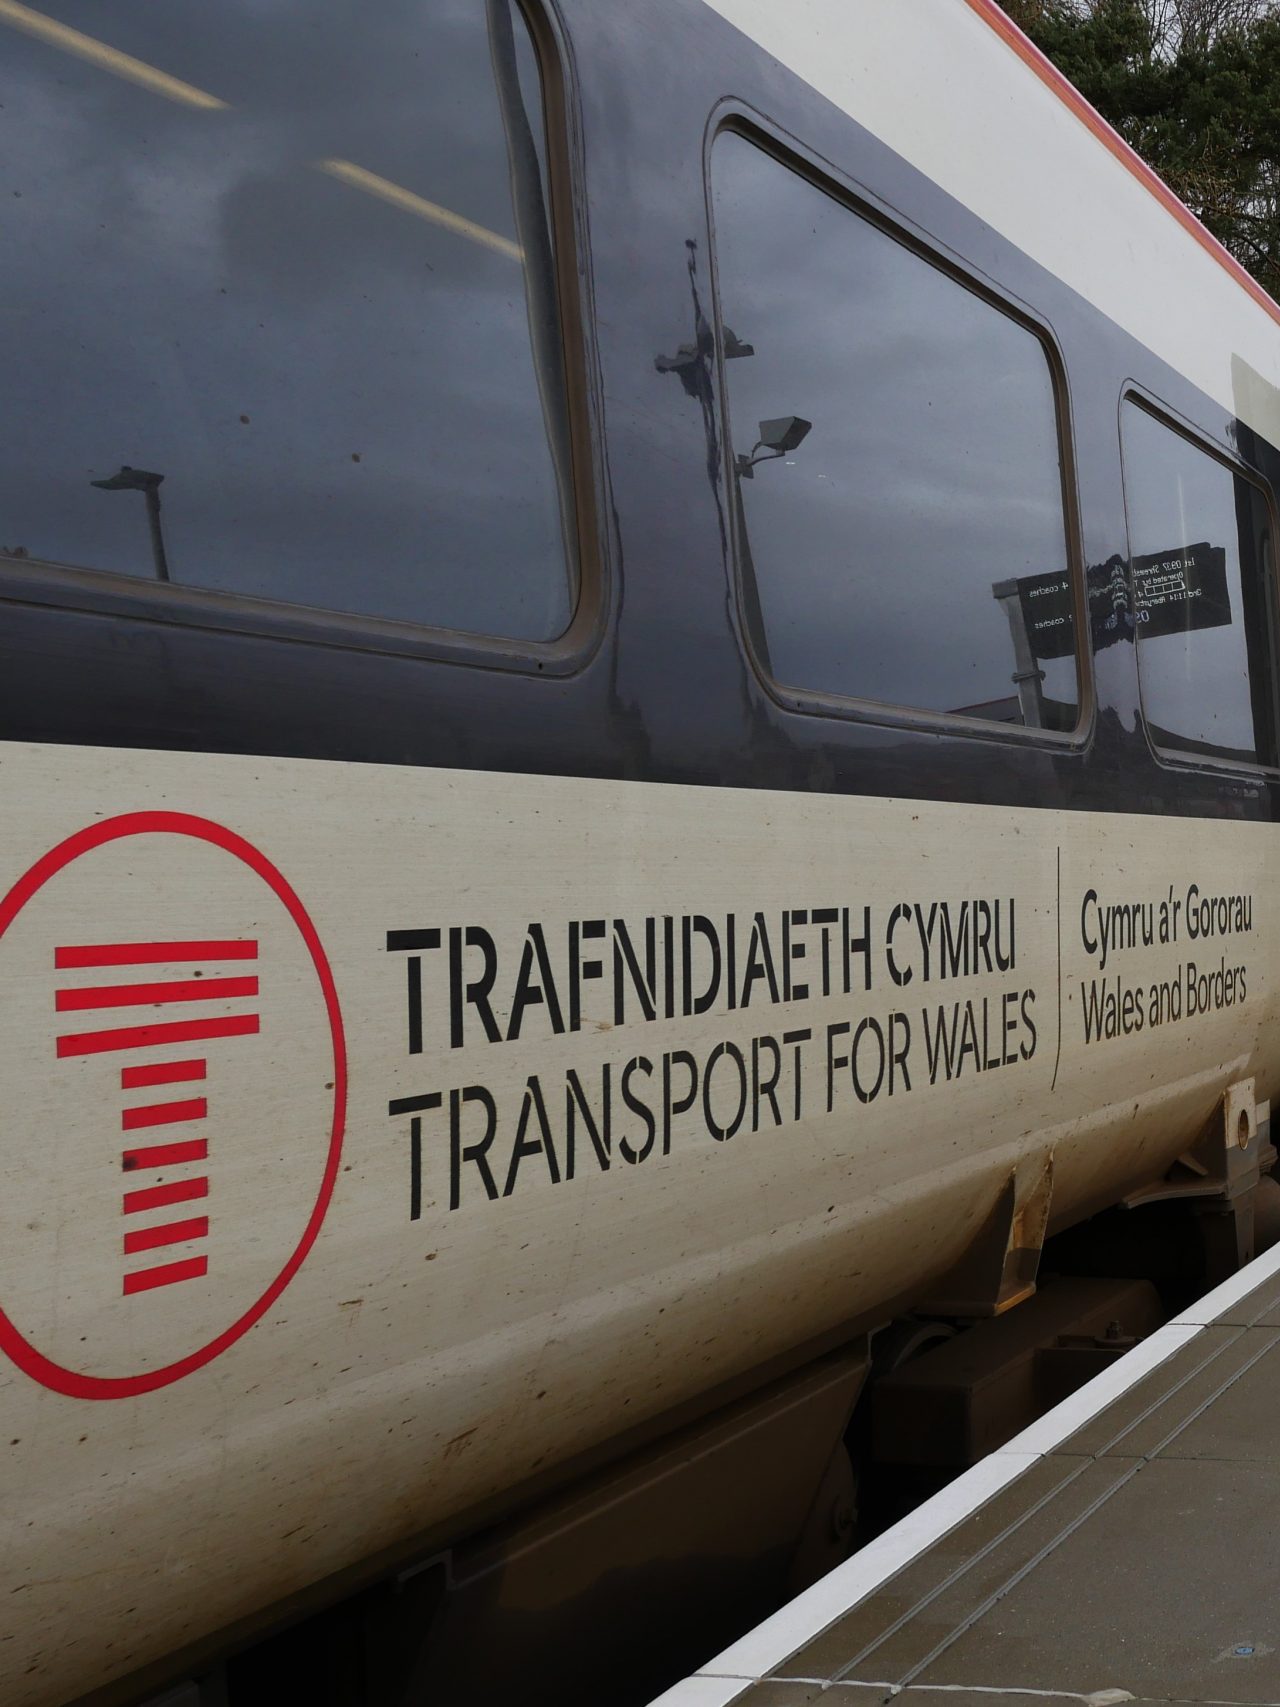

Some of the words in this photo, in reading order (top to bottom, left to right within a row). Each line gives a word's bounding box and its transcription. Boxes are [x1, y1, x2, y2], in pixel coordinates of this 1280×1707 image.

[386, 906, 872, 1055] TRAFNIDIAETH
[885, 898, 1015, 987] CYMRU
[1081, 888, 1154, 971] Cymru
[1159, 884, 1182, 945] a'r
[1186, 883, 1252, 940] Gororau
[1080, 975, 1144, 1045] Wales
[1149, 964, 1182, 1028] and
[1186, 956, 1247, 1018] Borders
[388, 1028, 812, 1222] TRANSPORT
[826, 1011, 912, 1113] FOR
[922, 988, 1037, 1086] WALES
